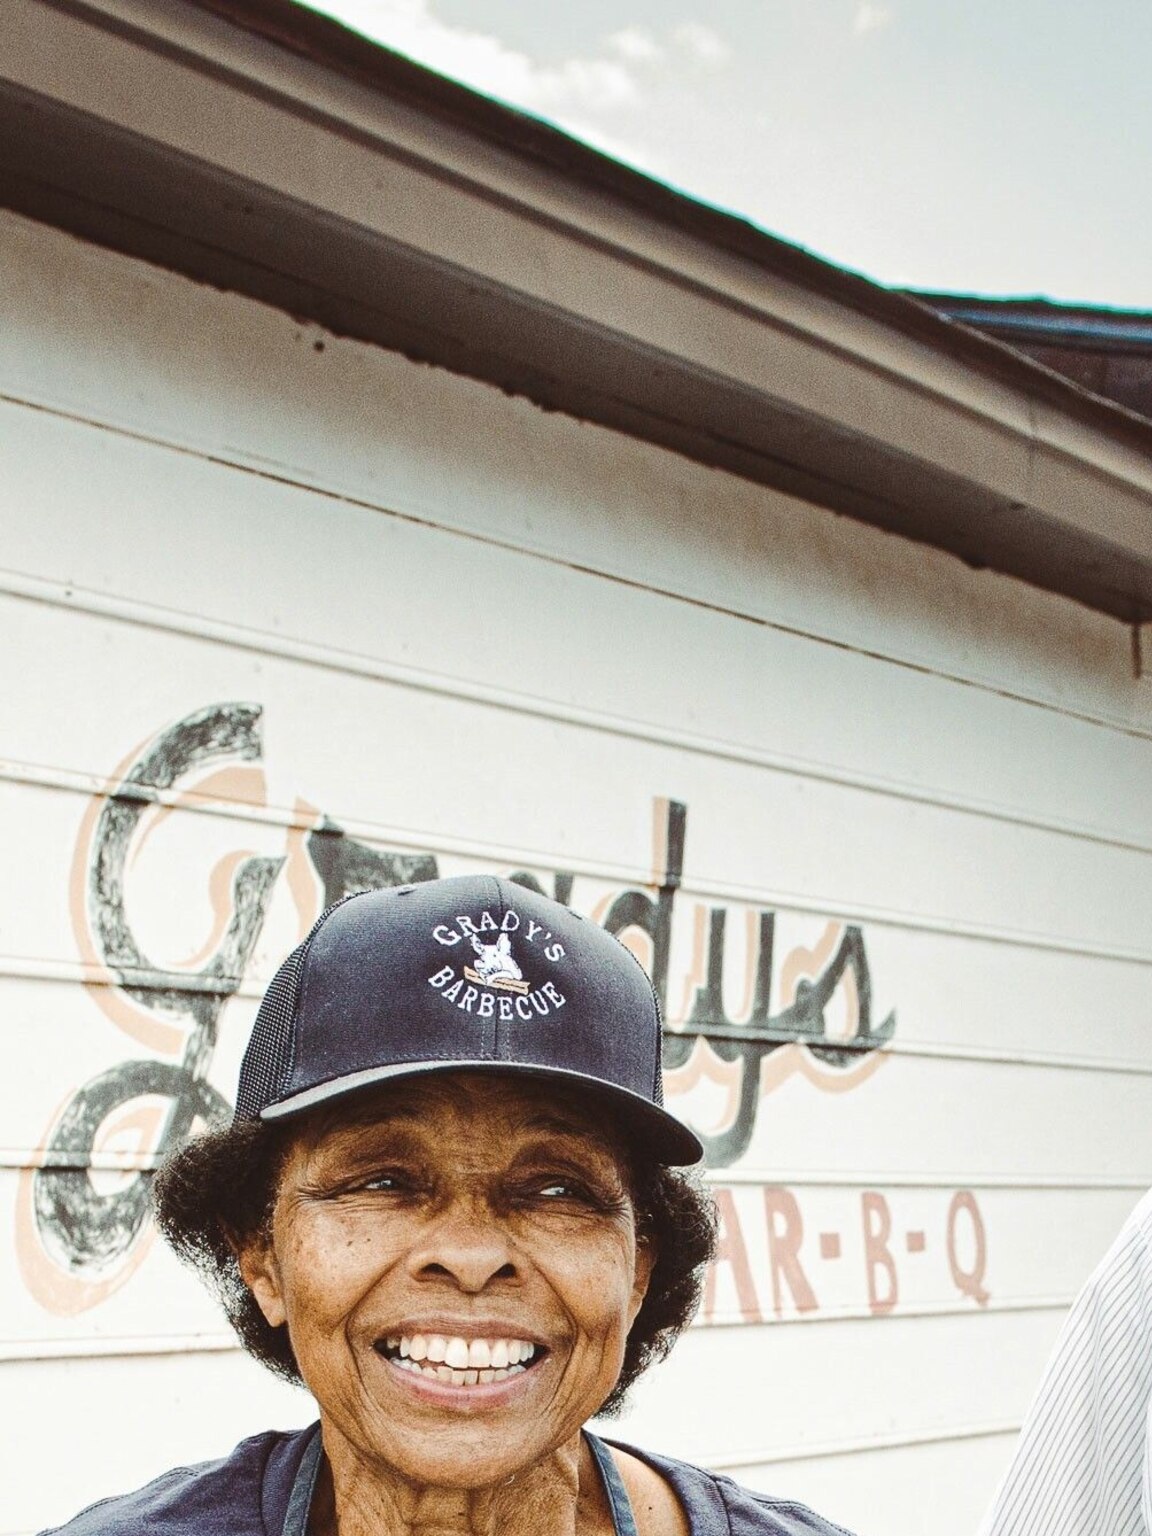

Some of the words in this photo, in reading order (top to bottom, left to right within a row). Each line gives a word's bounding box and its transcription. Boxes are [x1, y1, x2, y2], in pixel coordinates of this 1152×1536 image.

[432, 910, 566, 962] GRADY'S
[18, 700, 897, 1316] Grdys
[427, 965, 567, 1021] BARBECUE
[702, 1184, 991, 1326] AR-B-Q
